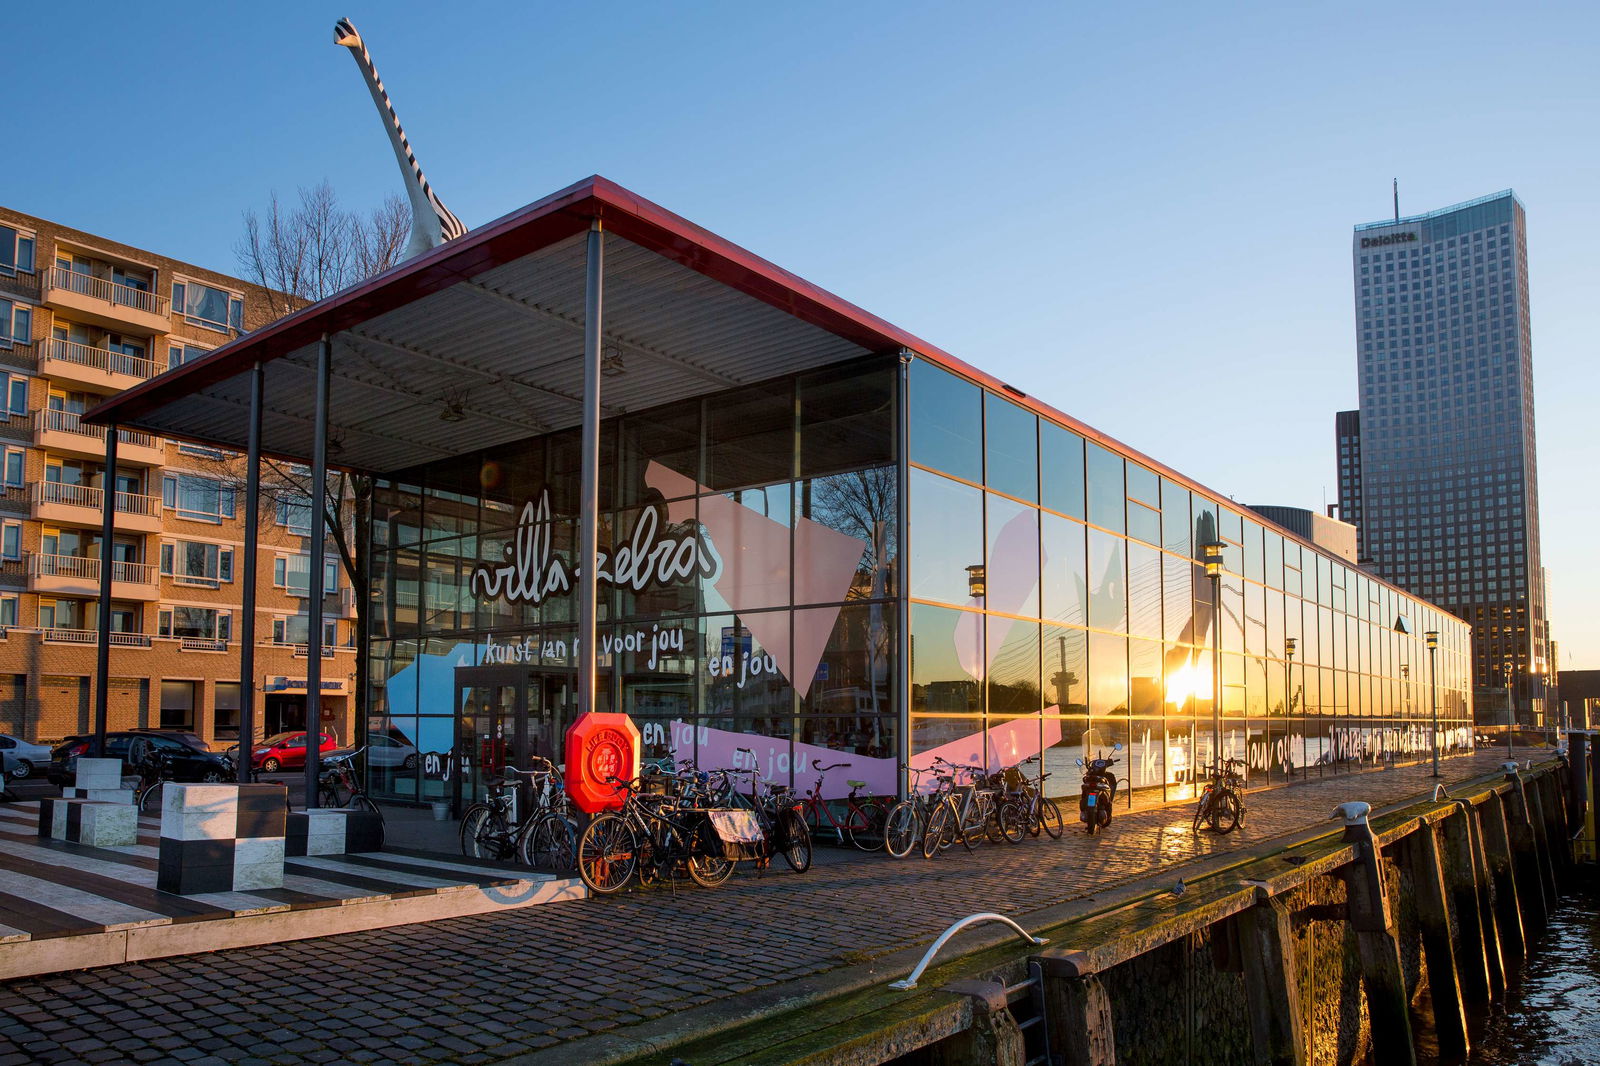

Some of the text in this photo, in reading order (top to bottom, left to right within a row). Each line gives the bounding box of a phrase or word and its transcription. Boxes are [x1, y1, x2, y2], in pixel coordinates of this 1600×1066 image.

[472, 489, 711, 602] villa zebra
[486, 634, 532, 664] kunst
[602, 630, 645, 655] voor
[648, 624, 684, 670] jou
[708, 651, 777, 689] en jou
[642, 717, 709, 755] en jou
[425, 750, 471, 782] en ju
[732, 748, 807, 781] en jou
[1140, 728, 1158, 787] ik
